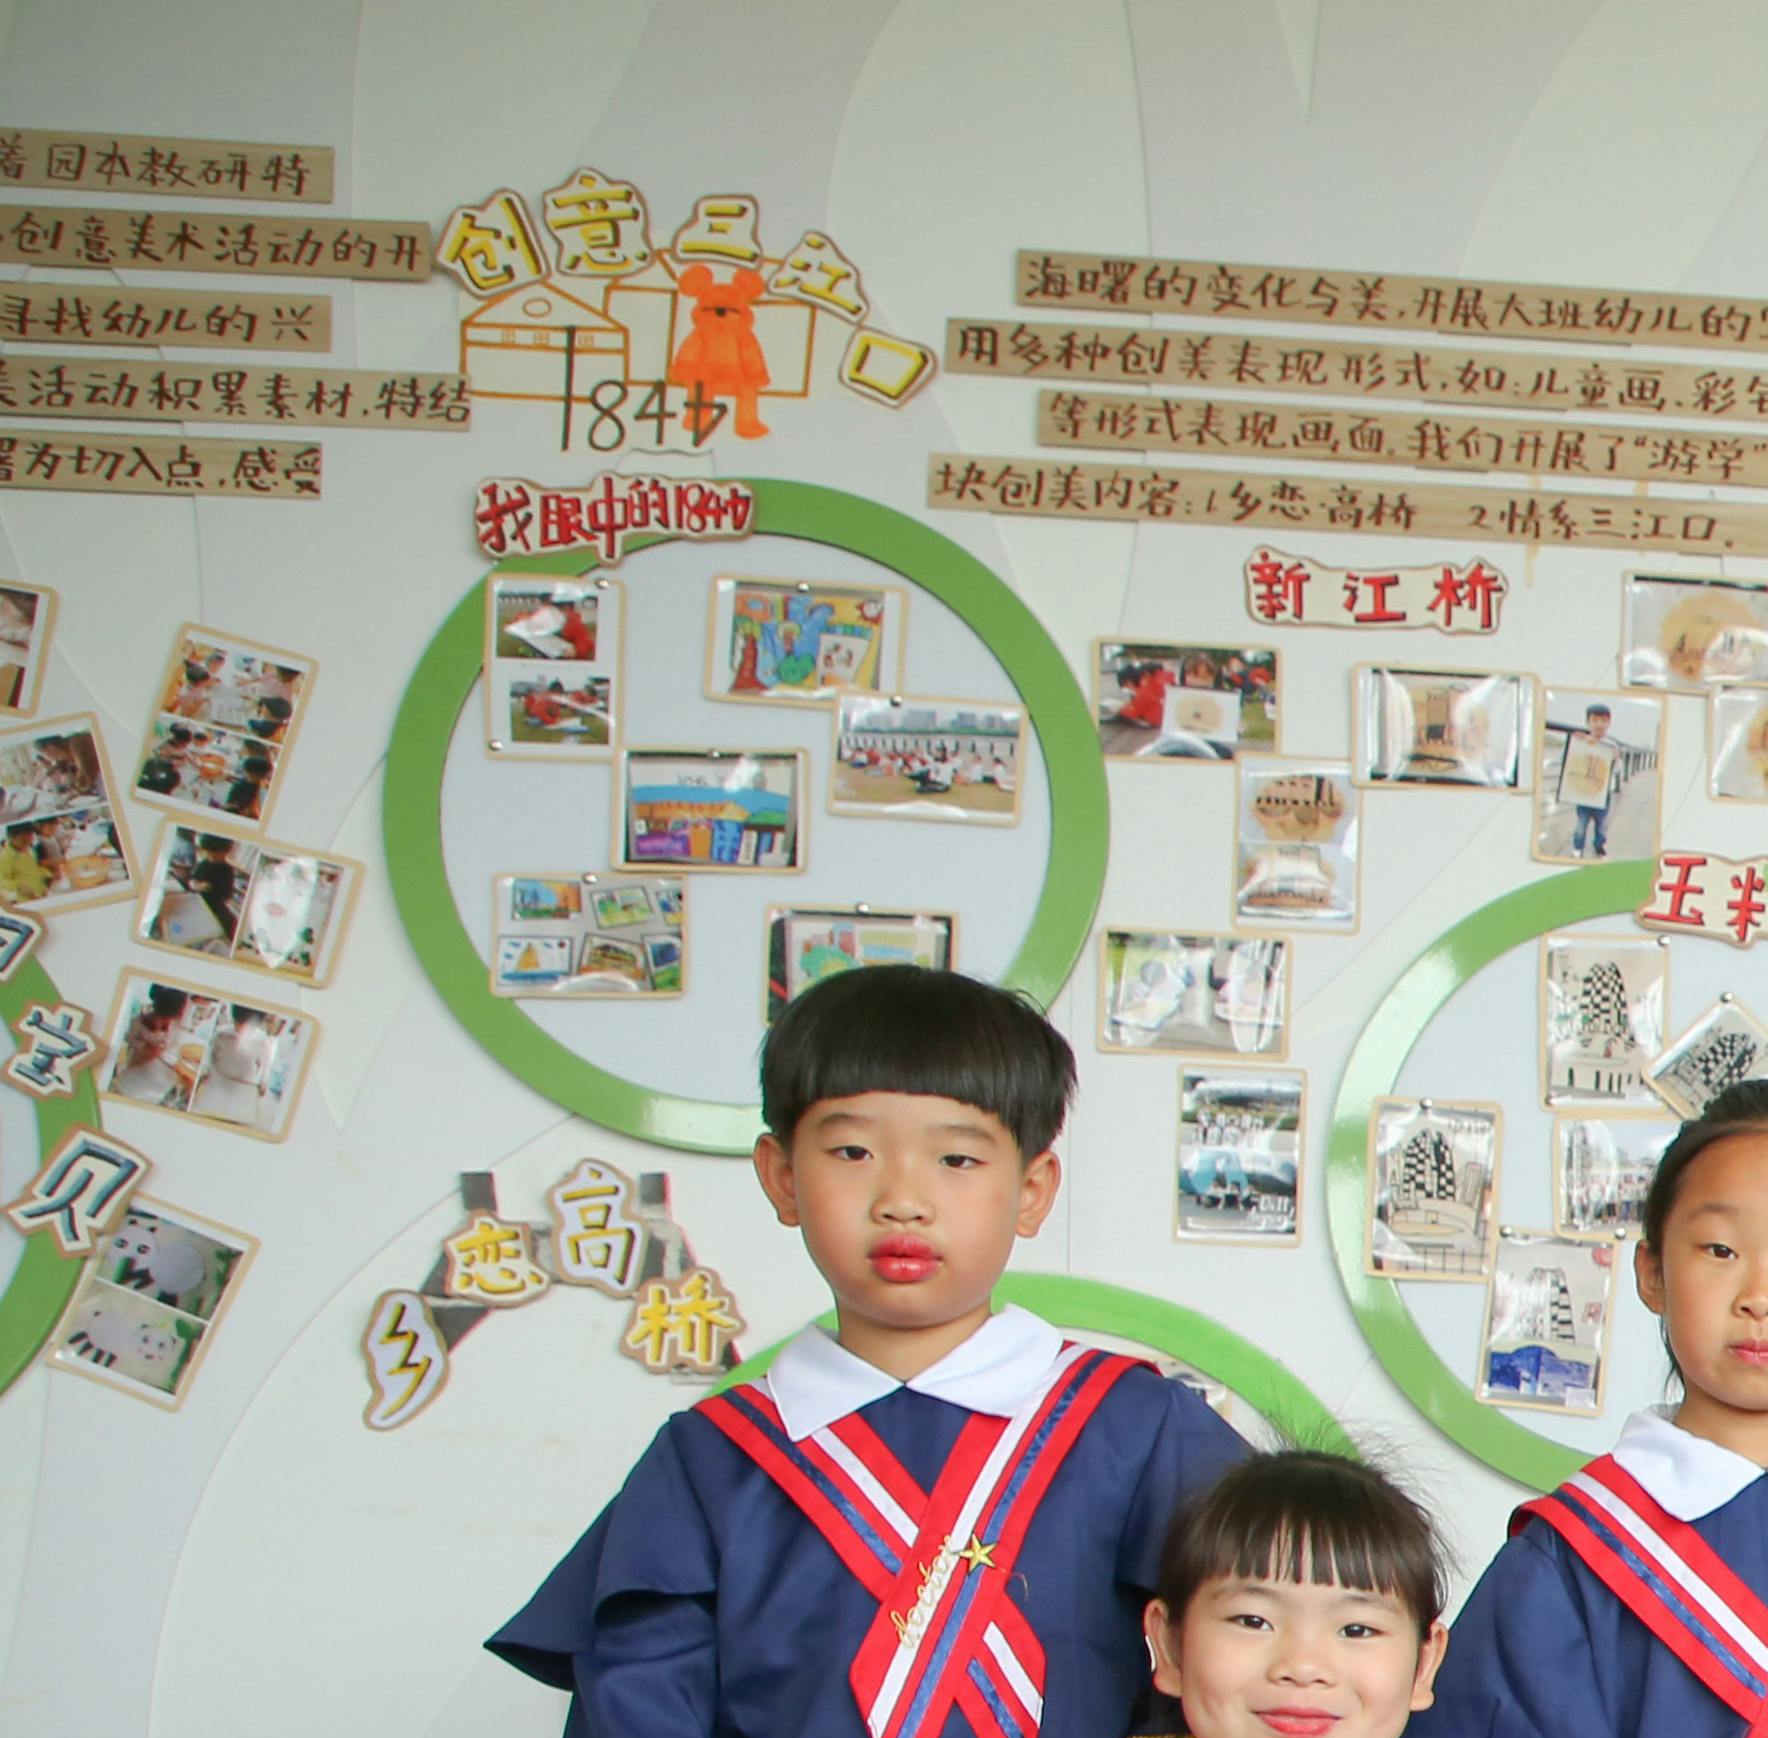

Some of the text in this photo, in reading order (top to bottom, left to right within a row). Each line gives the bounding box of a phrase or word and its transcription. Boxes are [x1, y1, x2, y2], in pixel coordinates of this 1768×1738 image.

[0, 211, 422, 271] 创意美术活动的开
[1251, 552, 1503, 628] 新江桥
